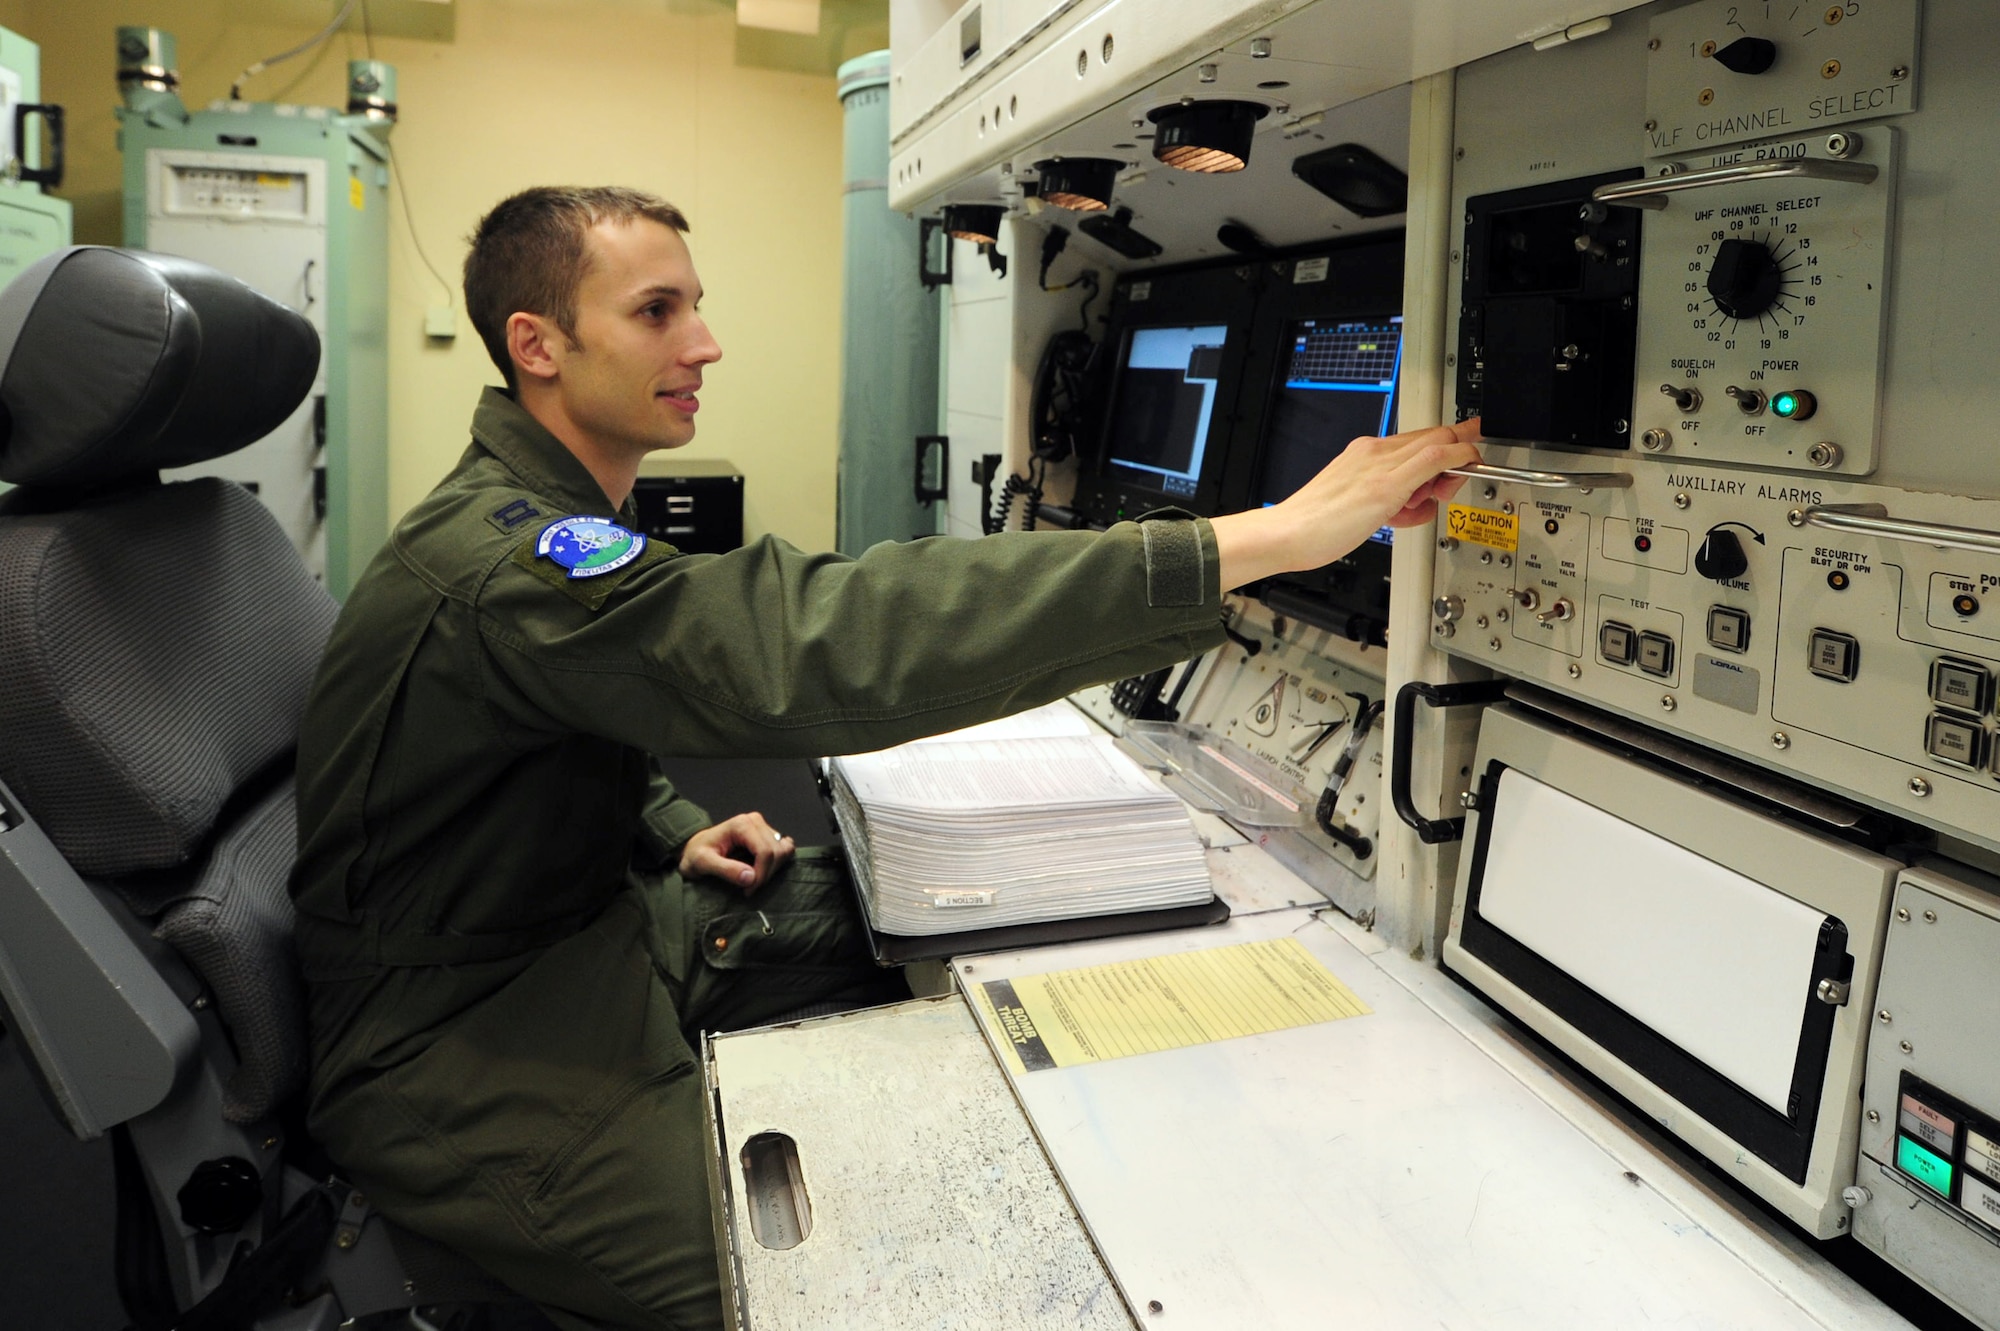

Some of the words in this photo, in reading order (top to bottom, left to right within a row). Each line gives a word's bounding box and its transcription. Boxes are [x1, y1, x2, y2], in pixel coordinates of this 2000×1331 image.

[1726, 7, 1738, 25] 2
[1689, 42, 1695, 58] 1
[1651, 128, 1683, 149] VLF
[1696, 107, 1792, 140] CHANNEL
[1808, 84, 1899, 120] SELECT
[1756, 143, 1807, 161] RADIO
[1695, 210, 1714, 221] UHF
[1721, 204, 1768, 218] CHANNEL
[1776, 197, 1821, 211] SELECT
[1730, 221, 1743, 231] 09
[1750, 216, 1760, 226] 10
[1770, 217, 1779, 226] 11
[1785, 224, 1797, 234] 12
[1799, 239, 1810, 249] 13
[1696, 245, 1710, 255] 07
[1807, 257, 1818, 266] 14
[1810, 276, 1822, 286] 15
[1684, 283, 1697, 292] 05
[1804, 296, 1816, 306] 16
[1687, 303, 1700, 313] 04
[1693, 319, 1706, 329] 03
[1794, 316, 1805, 326] 17
[1707, 332, 1720, 342] 02
[1778, 330, 1789, 340] 18
[1725, 340, 1736, 349] 01
[1760, 339, 1771, 349] 19
[1671, 359, 1715, 370] SQUELCH
[1762, 360, 1799, 371] POWER
[1686, 369, 1699, 379] ON
[1750, 370, 1764, 380] ON
[1681, 421, 1700, 431] OFF
[1745, 425, 1766, 436] OFF
[1667, 474, 1746, 496] AUXILIARY
[1757, 485, 1823, 505] ALARMS
[1536, 501, 1572, 514] EQUIPMENT
[1469, 512, 1513, 529] CAUTION
[1636, 518, 1654, 528] FIRE
[1815, 547, 1868, 564] SECURITY
[1837, 561, 1849, 570] DR
[1854, 564, 1871, 574] OPN
[1716, 578, 1750, 591] VOLUME
[1980, 574, 2000, 587] PO
[1949, 580, 1975, 593] STBY
[1630, 599, 1649, 610] TEST
[1710, 659, 1743, 673] LORAL
[952, 896, 984, 905] SECTION
[998, 1005, 1027, 1044] THREAT
[1011, 1008, 1037, 1038] BOMB
[1918, 1105, 1939, 1122] FAULT
[1919, 1122, 1936, 1134] SELF
[1918, 1129, 1936, 1142] TEST
[1914, 1153, 1936, 1171] POWER
[1920, 1165, 1929, 1174] ON
